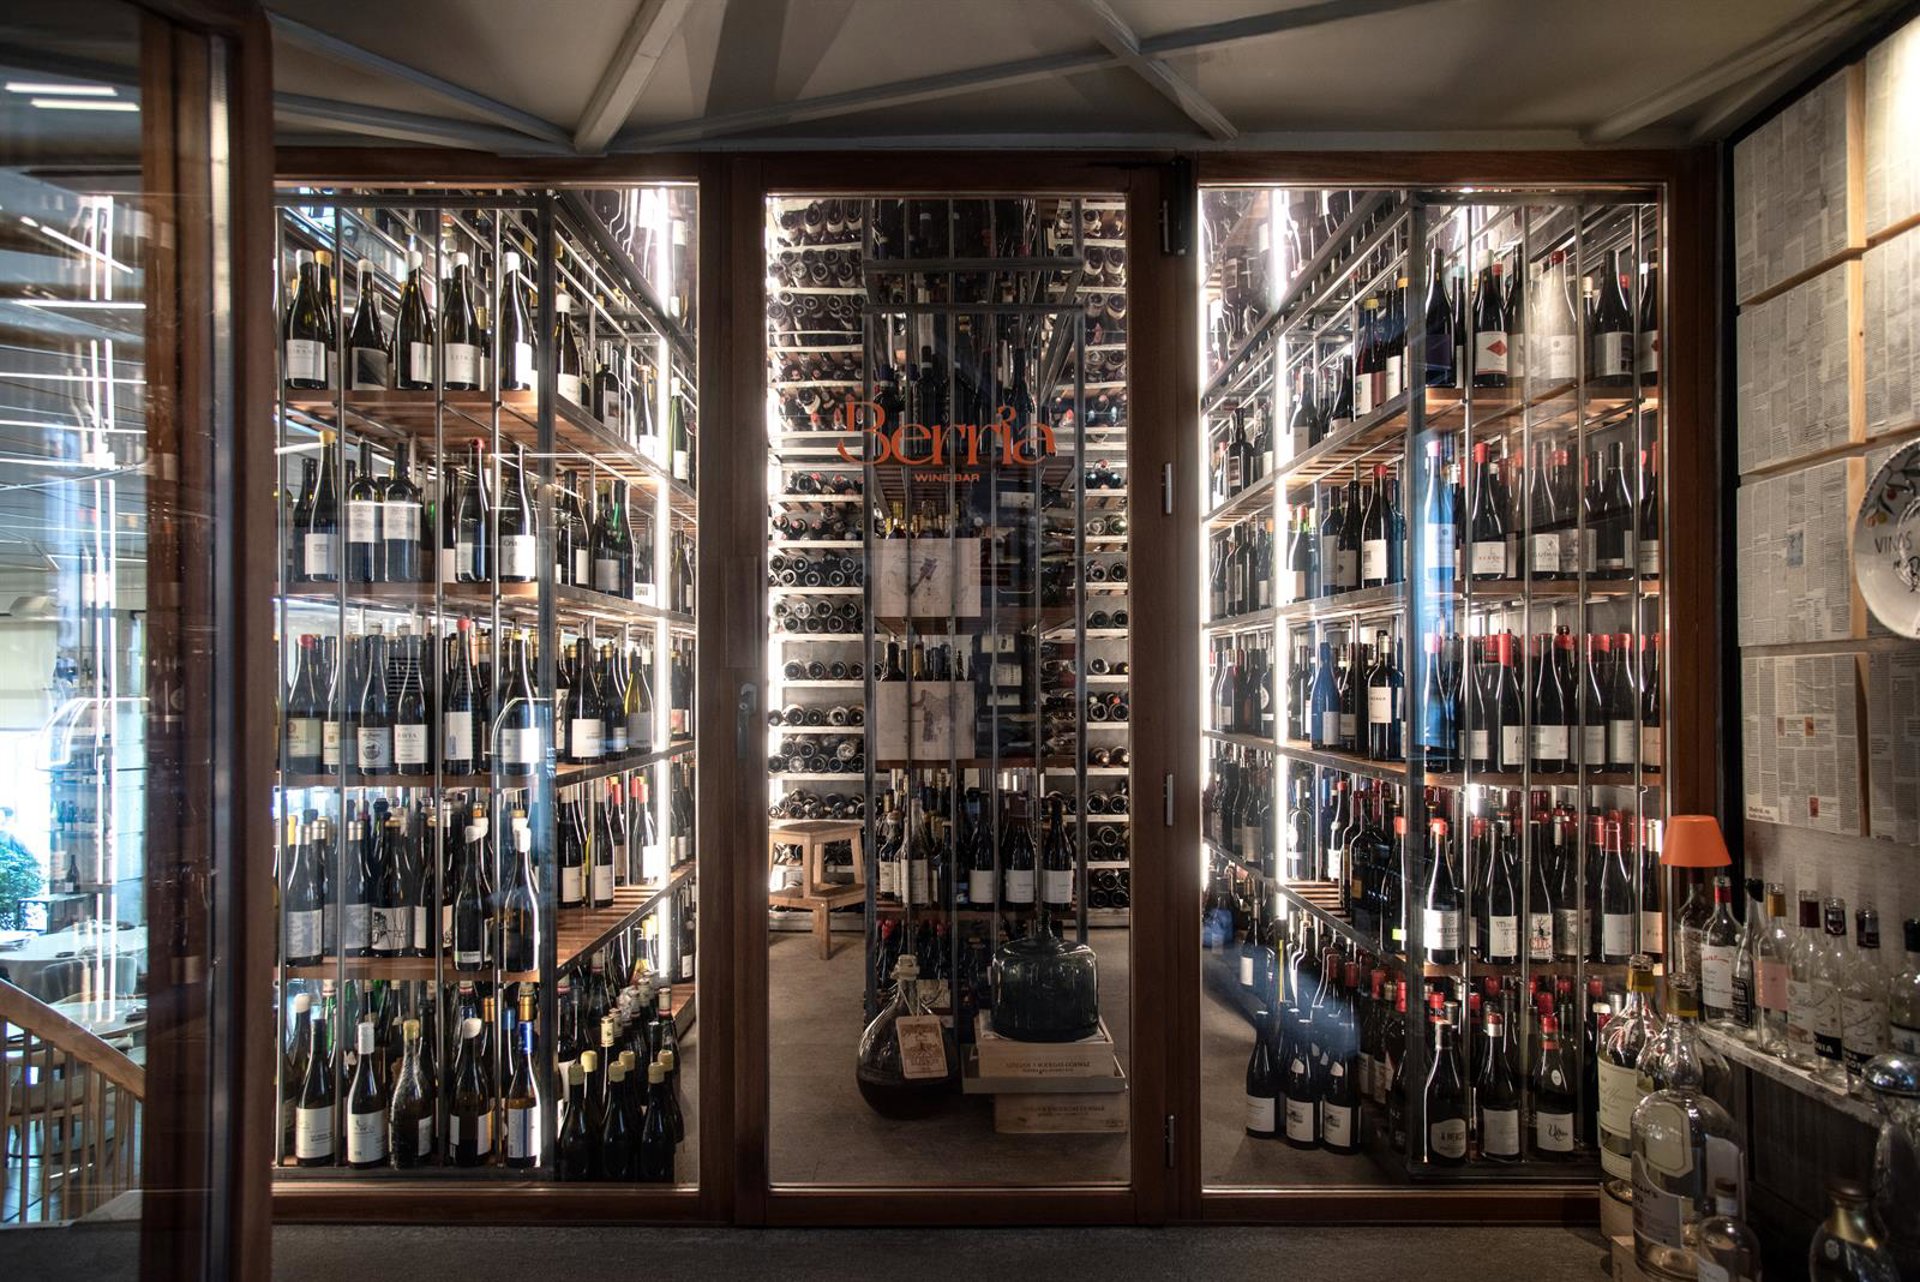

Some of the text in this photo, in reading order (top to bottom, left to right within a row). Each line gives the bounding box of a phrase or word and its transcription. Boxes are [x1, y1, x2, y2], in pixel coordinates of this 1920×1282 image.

[837, 401, 1057, 466] Berria
[915, 473, 980, 482] WINE BAR
